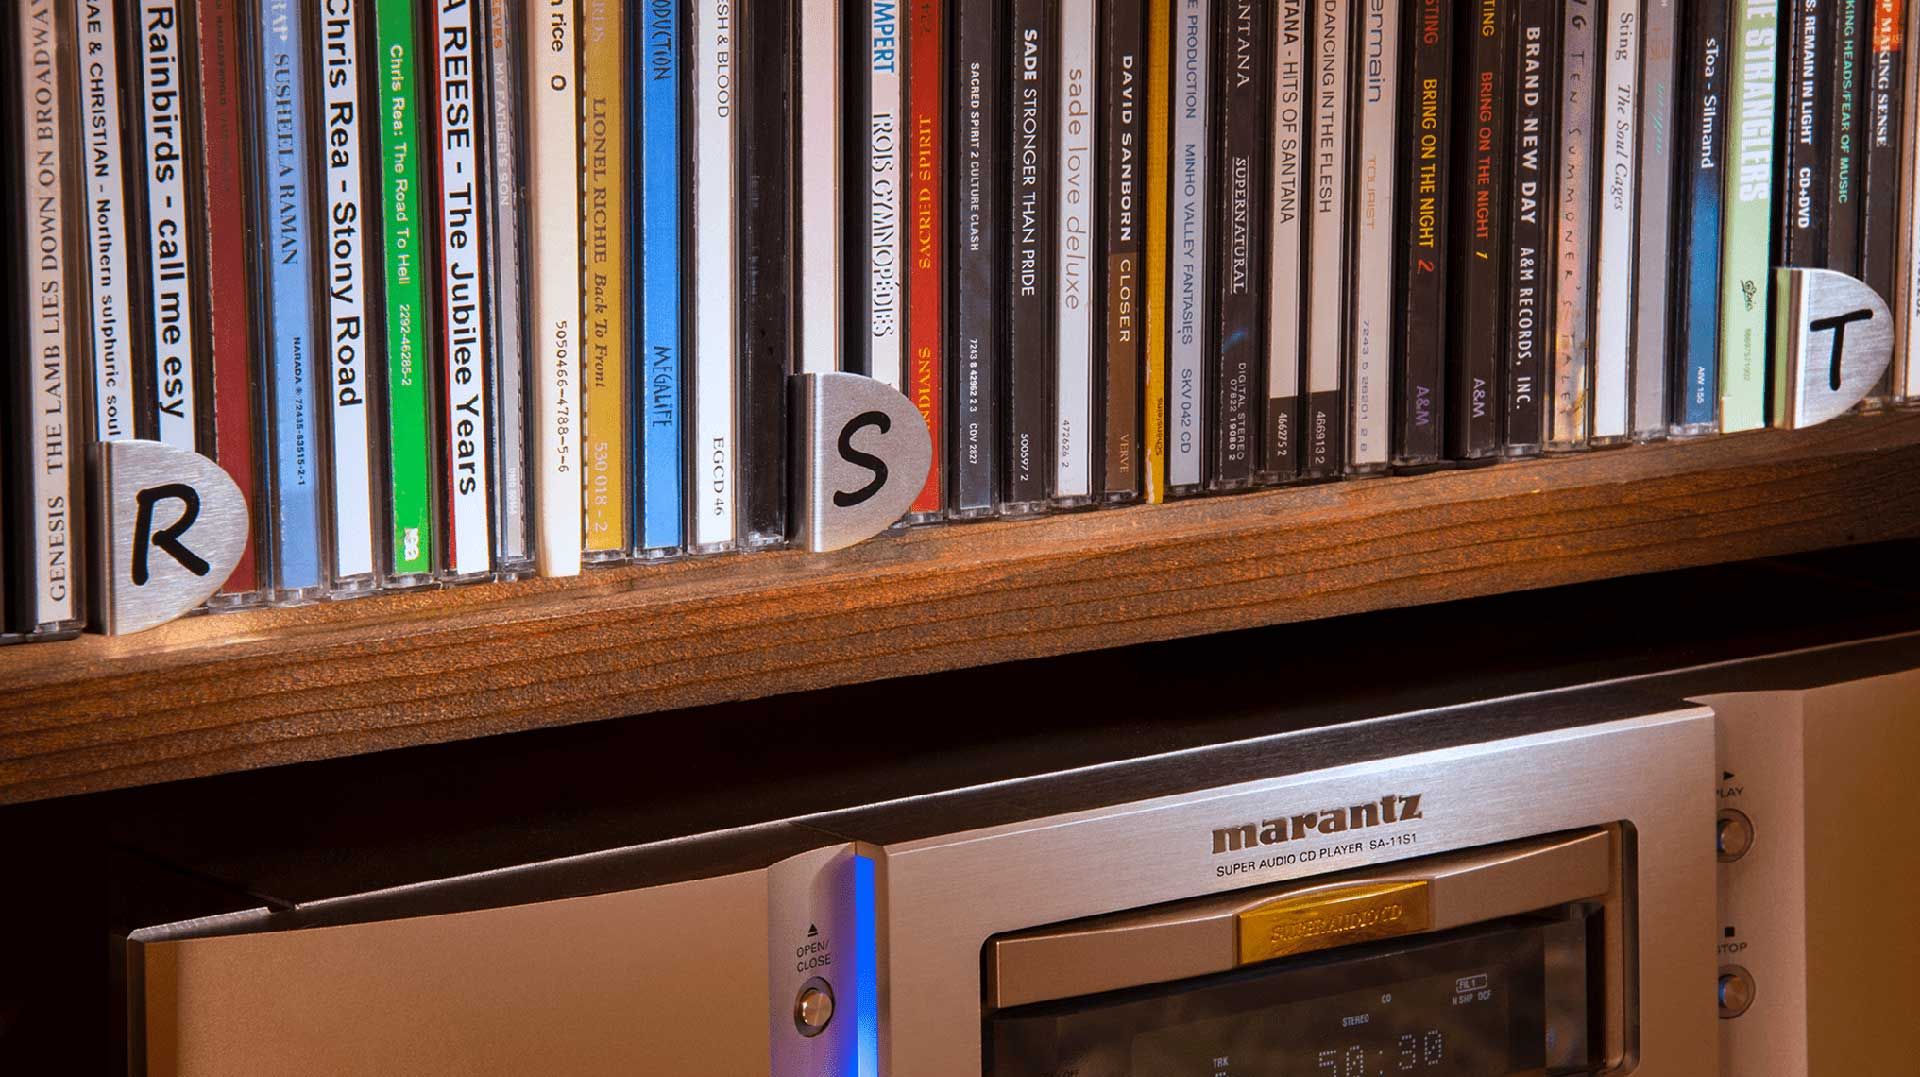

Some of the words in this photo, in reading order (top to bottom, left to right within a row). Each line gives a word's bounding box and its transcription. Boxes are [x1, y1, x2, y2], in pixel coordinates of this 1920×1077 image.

[86, 0, 101, 33] AE
[552, 13, 566, 51] rice
[874, 3, 895, 73] MPERT
[1616, 12, 1633, 60] Sting
[1843, 0, 1855, 35] KING
[327, 0, 352, 88] Chris
[390, 45, 404, 91] Chris
[1024, 29, 1037, 80] SADE
[1185, 15, 1198, 119] PRODUCTION
[1236, 0, 1251, 87] NTANA
[1322, 0, 1337, 86] DANCING
[1524, 27, 1540, 105] BRAND
[1705, 38, 1718, 77] sToa
[1803, 16, 1816, 76] REMAIN
[1878, 18, 1891, 89] MAKING
[29, 0, 53, 140] BROADWA
[147, 7, 179, 182] Rainbirds
[443, 27, 470, 149] REESE
[494, 63, 505, 93] MY
[717, 51, 729, 118] BLOOD
[970, 63, 980, 108] SACRED
[1121, 55, 1133, 124] DAVID
[1282, 61, 1298, 102] HITS
[1803, 81, 1814, 96] IN
[91, 62, 109, 177] CHRISTIAN
[274, 54, 295, 176] SUSHEELA
[392, 97, 406, 136] Rea:
[1068, 69, 1088, 135] sade
[1282, 109, 1297, 133] OF
[1322, 92, 1335, 107] IN
[1421, 79, 1437, 128] BRING
[1480, 72, 1493, 122] BRING
[1617, 84, 1630, 114] The
[1739, 28, 1776, 201] STRANGLERS
[1876, 93, 1889, 147] SENSE
[331, 101, 354, 168] Rea
[495, 98, 509, 167] FATHER'S
[593, 98, 607, 181] LIONEL
[919, 115, 931, 180] SPIRIT
[970, 111, 980, 148] SPIRIT
[1022, 88, 1037, 185] STRONGER
[1321, 117, 1334, 147] THE
[1421, 135, 1436, 159] ON
[1479, 127, 1491, 151] ON
[1522, 118, 1538, 170] NEW
[1615, 123, 1628, 158] Soul
[1701, 95, 1717, 168] Silmand
[1801, 102, 1813, 145] LIGHT
[1840, 135, 1850, 153] OF
[37, 151, 55, 187] ON
[394, 143, 407, 178] The
[970, 161, 980, 210] CULTURE
[1067, 147, 1088, 204] love
[1184, 144, 1196, 197] MINHO
[1280, 139, 1297, 223] SANTANA
[1319, 153, 1333, 212] FLESH
[1420, 164, 1436, 193] THE
[1478, 156, 1490, 184] THE
[1839, 157, 1849, 204] MUSIC
[395, 179, 408, 221] Road
[498, 172, 509, 205] SON
[1120, 133, 1132, 241] SANBORN
[1366, 156, 1377, 231] TOURIST
[1521, 182, 1536, 224] DAY
[1611, 163, 1627, 211] Cages
[1798, 168, 1810, 228] CD+DVD
[39, 196, 57, 270] DOWN
[279, 185, 298, 264] RAMAN
[396, 227, 409, 248] To
[449, 182, 472, 248] The
[594, 187, 607, 263] RICHIE
[919, 188, 931, 269] SACRED
[970, 214, 979, 250] CLASH
[1022, 192, 1035, 242] THAN
[1183, 202, 1195, 257] VALLEY
[1233, 157, 1247, 294] SUPERNATURAL
[1419, 198, 1434, 248] NIGHT
[1476, 191, 1489, 239] NIGHT
[97, 200, 112, 286] Northern
[158, 219, 185, 280] call
[331, 202, 357, 303] Stony
[1065, 216, 1086, 309] deluxe
[1520, 247, 1535, 280] A&M
[398, 255, 411, 284] Hell
[594, 272, 607, 313] Back
[1022, 250, 1035, 296] PRIDE
[42, 281, 60, 334] LIES
[161, 292, 183, 344] me
[451, 263, 476, 384] Jubilee
[1118, 259, 1131, 342] CLOSER
[1182, 264, 1194, 344] FANTASIES
[101, 295, 119, 387] sulphuric
[400, 304, 412, 385] 2292-46285-2
[595, 319, 607, 338] To
[969, 338, 977, 359] 7243
[1516, 288, 1534, 366] RECORDS,
[1811, 309, 1873, 390] T
[43, 345, 61, 414] LAMB
[293, 337, 302, 384] NARADA
[336, 316, 362, 406] Road
[594, 344, 608, 387] Front
[1181, 368, 1192, 399] SKV
[1237, 363, 1246, 408] DIGITAL
[160, 356, 185, 418] esy
[556, 320, 569, 472] 5050466-4788-5-6
[1416, 385, 1430, 426] A&M
[1473, 378, 1485, 418] A&M
[1516, 377, 1530, 409] INC.
[107, 395, 121, 436] soul
[1181, 402, 1192, 425] 042
[1236, 412, 1246, 460] STEREO
[46, 424, 63, 474] THE
[457, 395, 479, 495] Years
[595, 441, 607, 470] 530
[713, 437, 724, 493] EGCD
[833, 411, 891, 507] S
[1020, 433, 1029, 471] 500597
[1119, 434, 1129, 472] VERVE
[1180, 432, 1192, 453] CD
[595, 475, 607, 505] 018
[714, 498, 724, 516] 46
[48, 496, 66, 601] GENESIS
[133, 484, 210, 585] R
[1716, 787, 1744, 798] LAY
[1212, 794, 1422, 854] marantz
[1217, 860, 1255, 876] SUPER
[1259, 854, 1295, 869] AUDIO
[1300, 850, 1315, 862] CD
[1319, 842, 1362, 858] PLAYER
[1370, 833, 1416, 849] SA-11S1
[797, 940, 830, 958] OPEN/
[797, 954, 832, 972] CLOSE
[1342, 1014, 1369, 1028] STEREO
[1213, 1056, 1229, 1068] TRK
